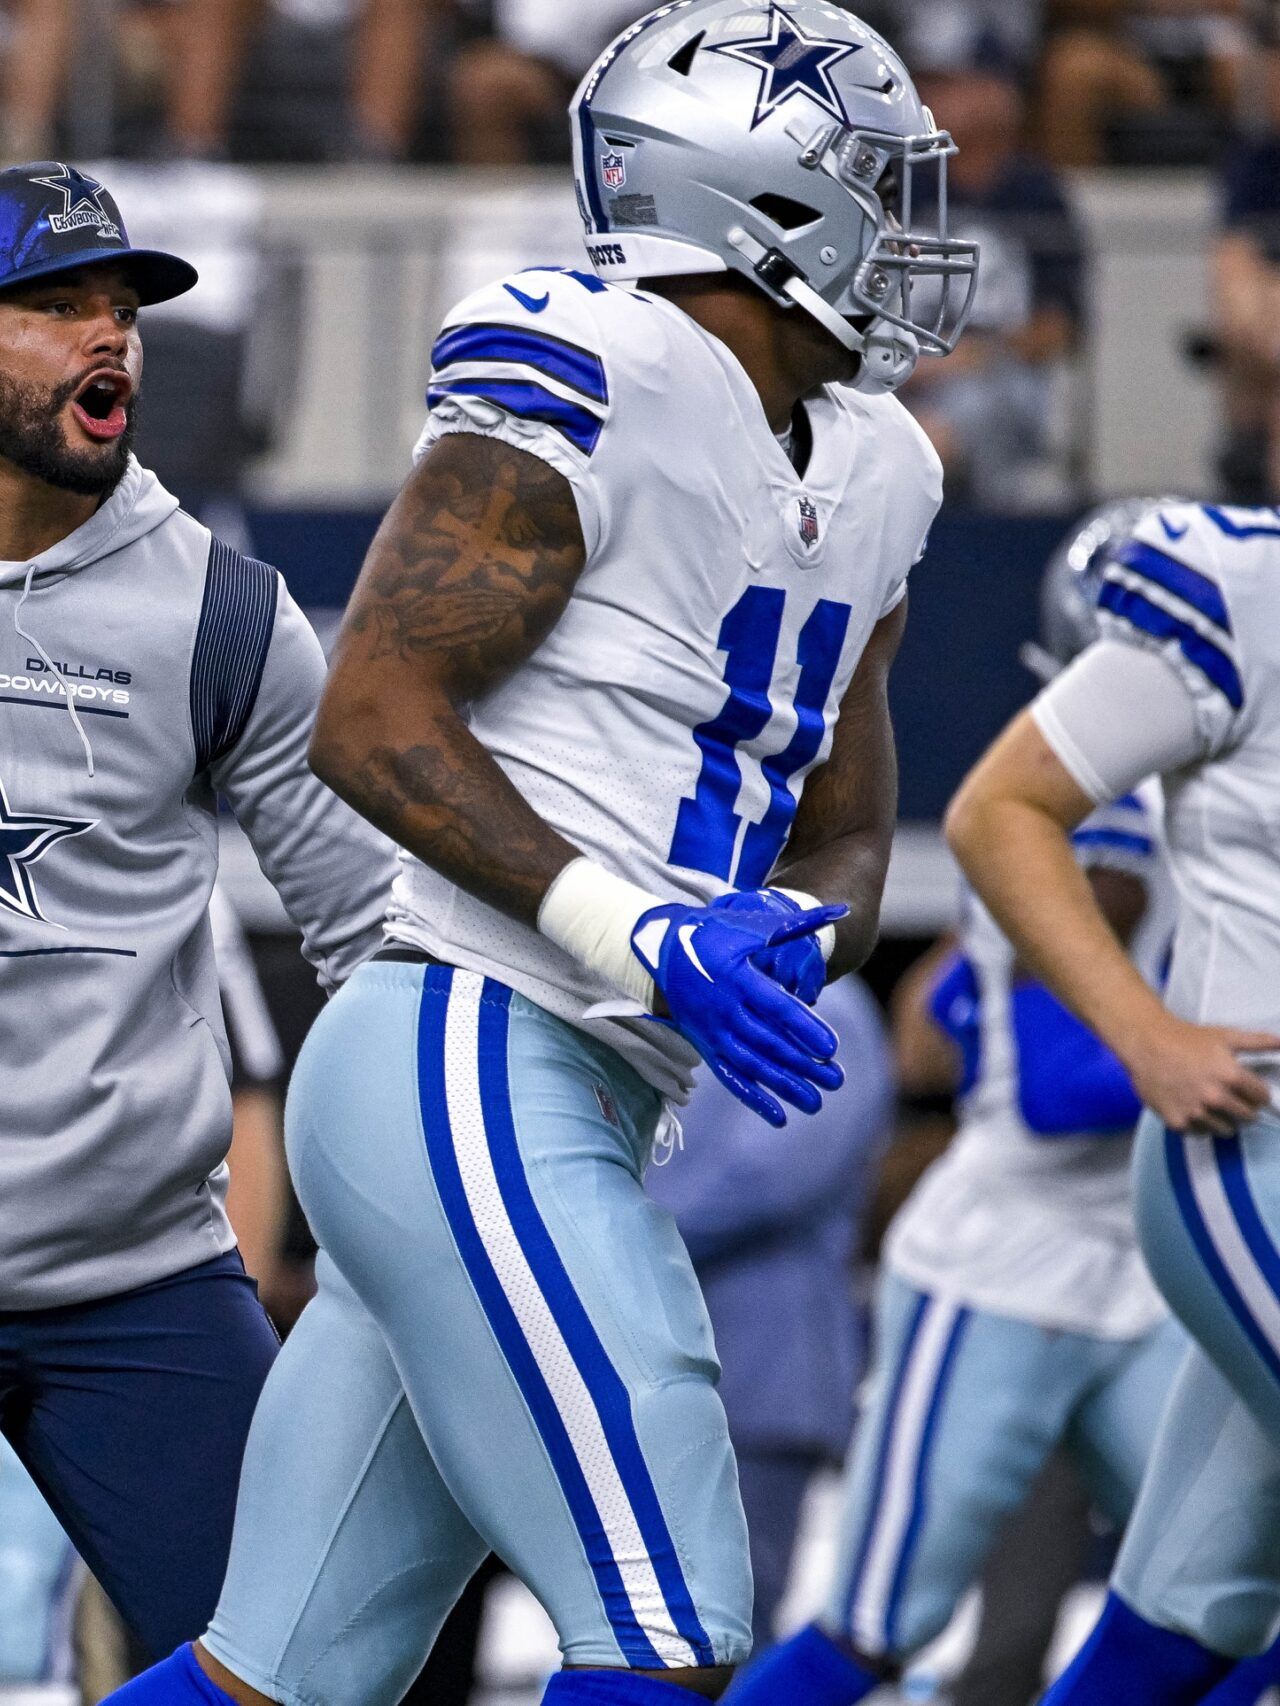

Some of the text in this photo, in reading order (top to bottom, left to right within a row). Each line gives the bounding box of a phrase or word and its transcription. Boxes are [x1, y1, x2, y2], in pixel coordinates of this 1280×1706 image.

[603, 167, 624, 186] NFL
[53, 210, 101, 231] COWBOYS
[25, 657, 133, 686] DALLAS
[667, 584, 853, 891] 11
